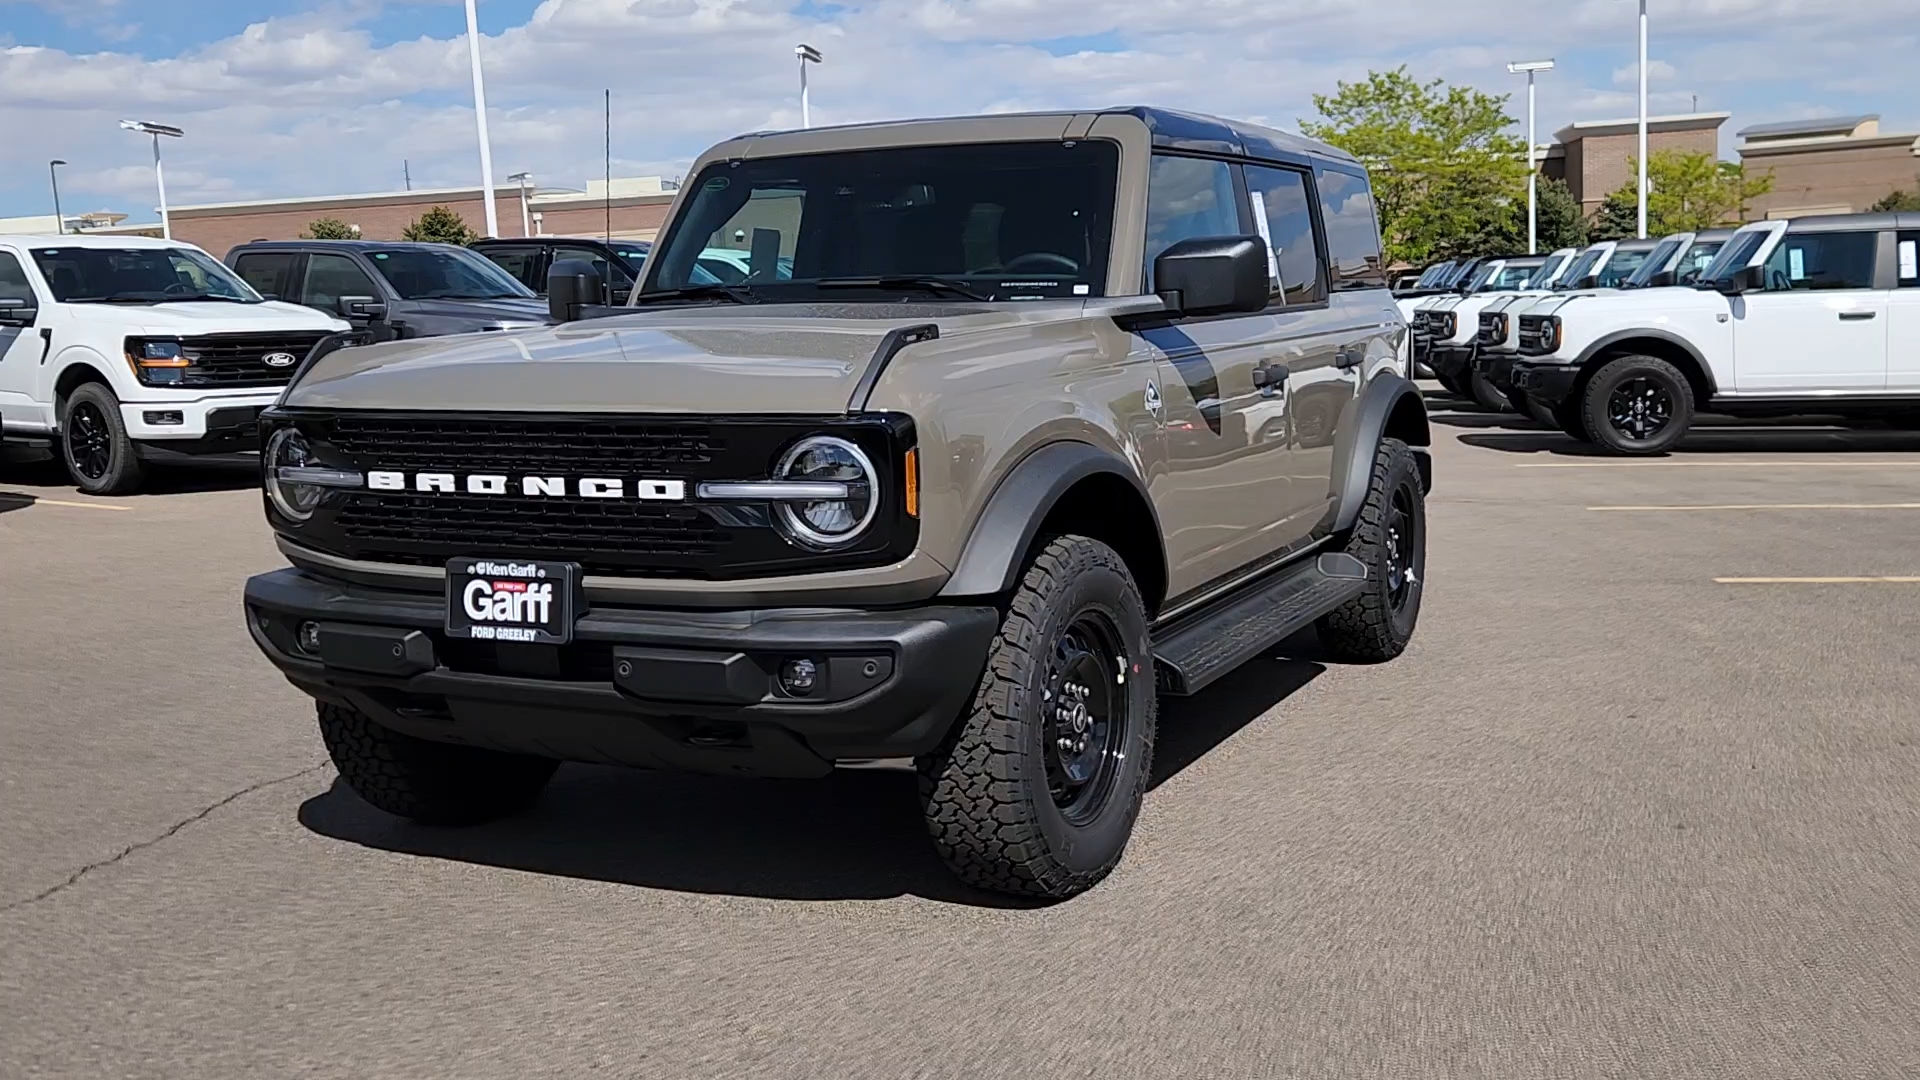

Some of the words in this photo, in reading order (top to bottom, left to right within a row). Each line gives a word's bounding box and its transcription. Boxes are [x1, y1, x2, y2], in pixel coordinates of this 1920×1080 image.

[367, 471, 685, 500] BRONCO
[485, 562, 508, 576] Ken
[508, 563, 537, 578] Garff
[463, 579, 552, 624] Garff
[471, 626, 495, 639] FORD
[496, 627, 537, 642] GREELEY
